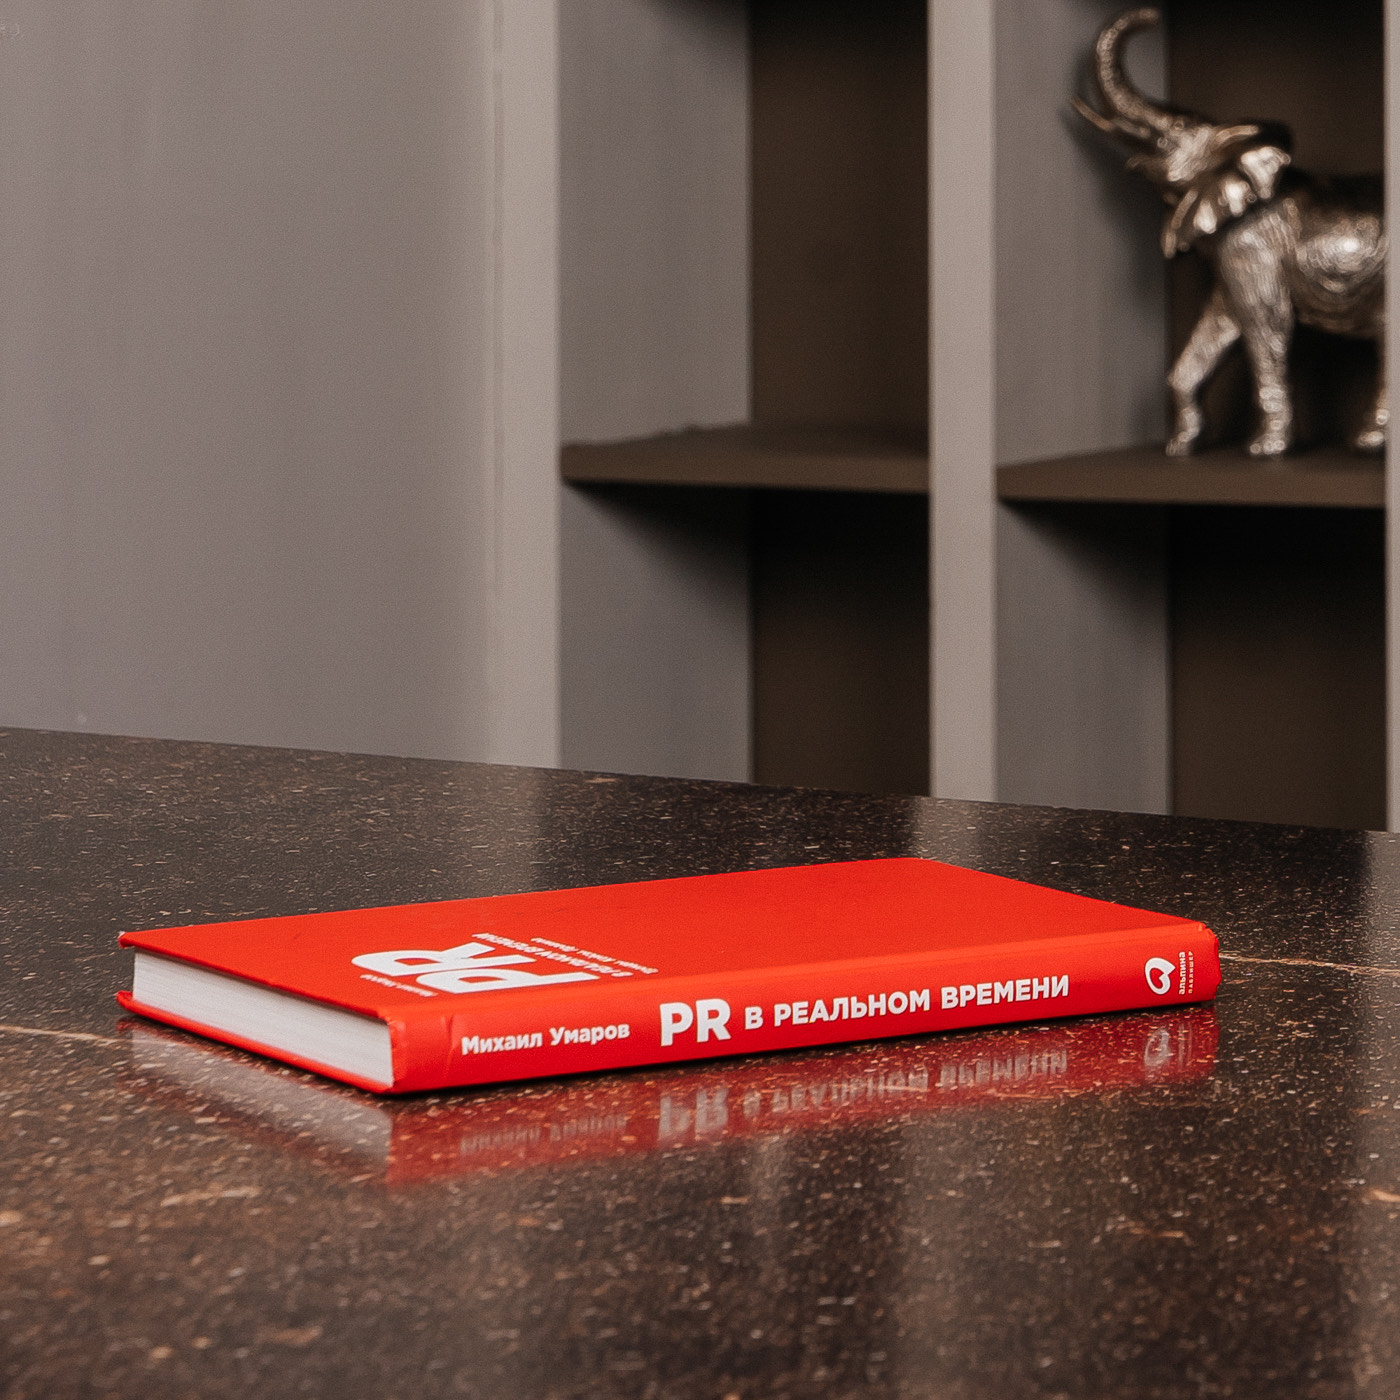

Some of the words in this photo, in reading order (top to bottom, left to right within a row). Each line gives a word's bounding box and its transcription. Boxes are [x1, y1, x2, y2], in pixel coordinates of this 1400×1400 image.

[350, 941, 601, 995] PR
[659, 998, 732, 1047] PR
[744, 1006, 764, 1030] В
[773, 988, 931, 1027] РЕАЛЬНОМ
[940, 974, 1070, 1009] ВРЕМЕНИ
[461, 1032, 543, 1056] Михаил
[549, 1023, 631, 1047] Умаров
